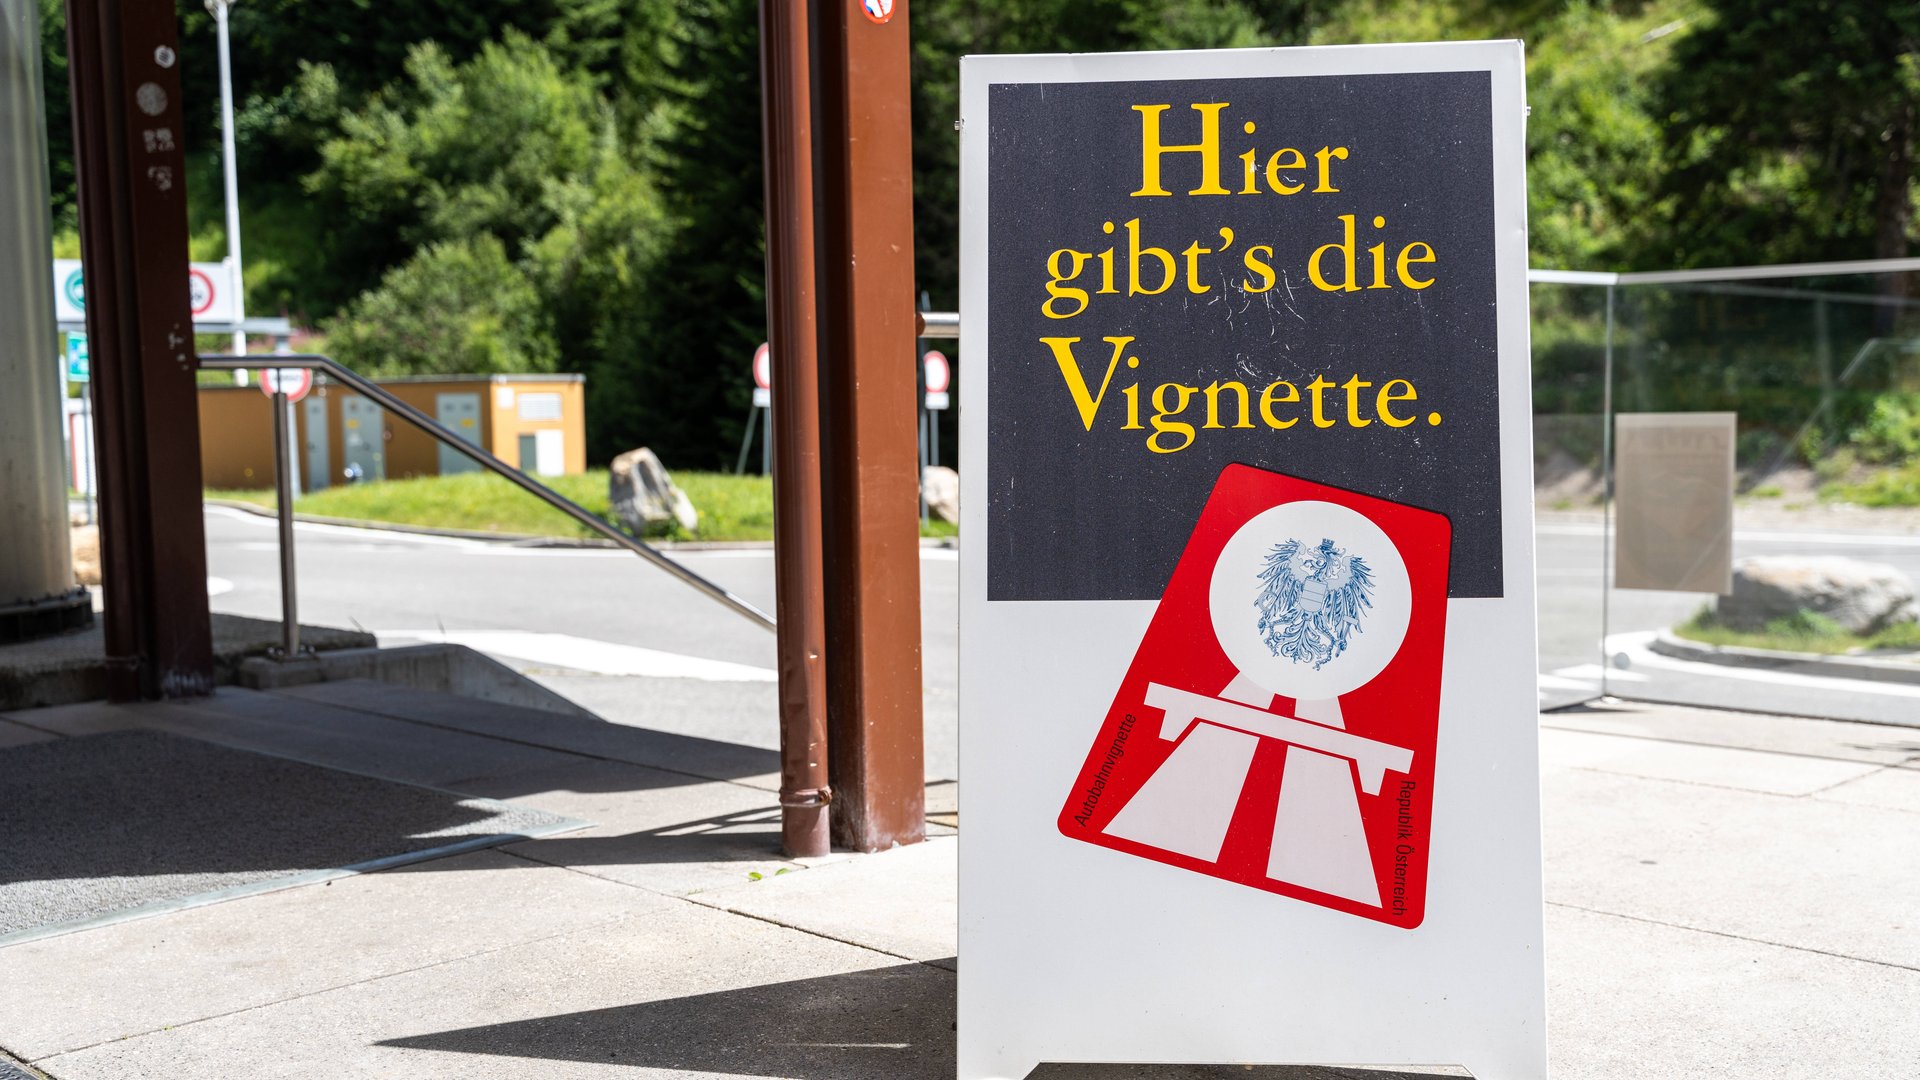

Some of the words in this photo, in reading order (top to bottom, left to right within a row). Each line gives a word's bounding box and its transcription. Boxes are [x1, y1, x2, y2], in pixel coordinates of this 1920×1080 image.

[1130, 102, 1349, 197] Hier
[1041, 217, 1276, 320] gibt’s
[1307, 214, 1437, 293] die
[1039, 335, 1443, 454] Vignette.
[1074, 713, 1137, 828] Autobahnvignette
[1396, 780, 1416, 840] Republik
[1391, 844, 1415, 917] Österreich
